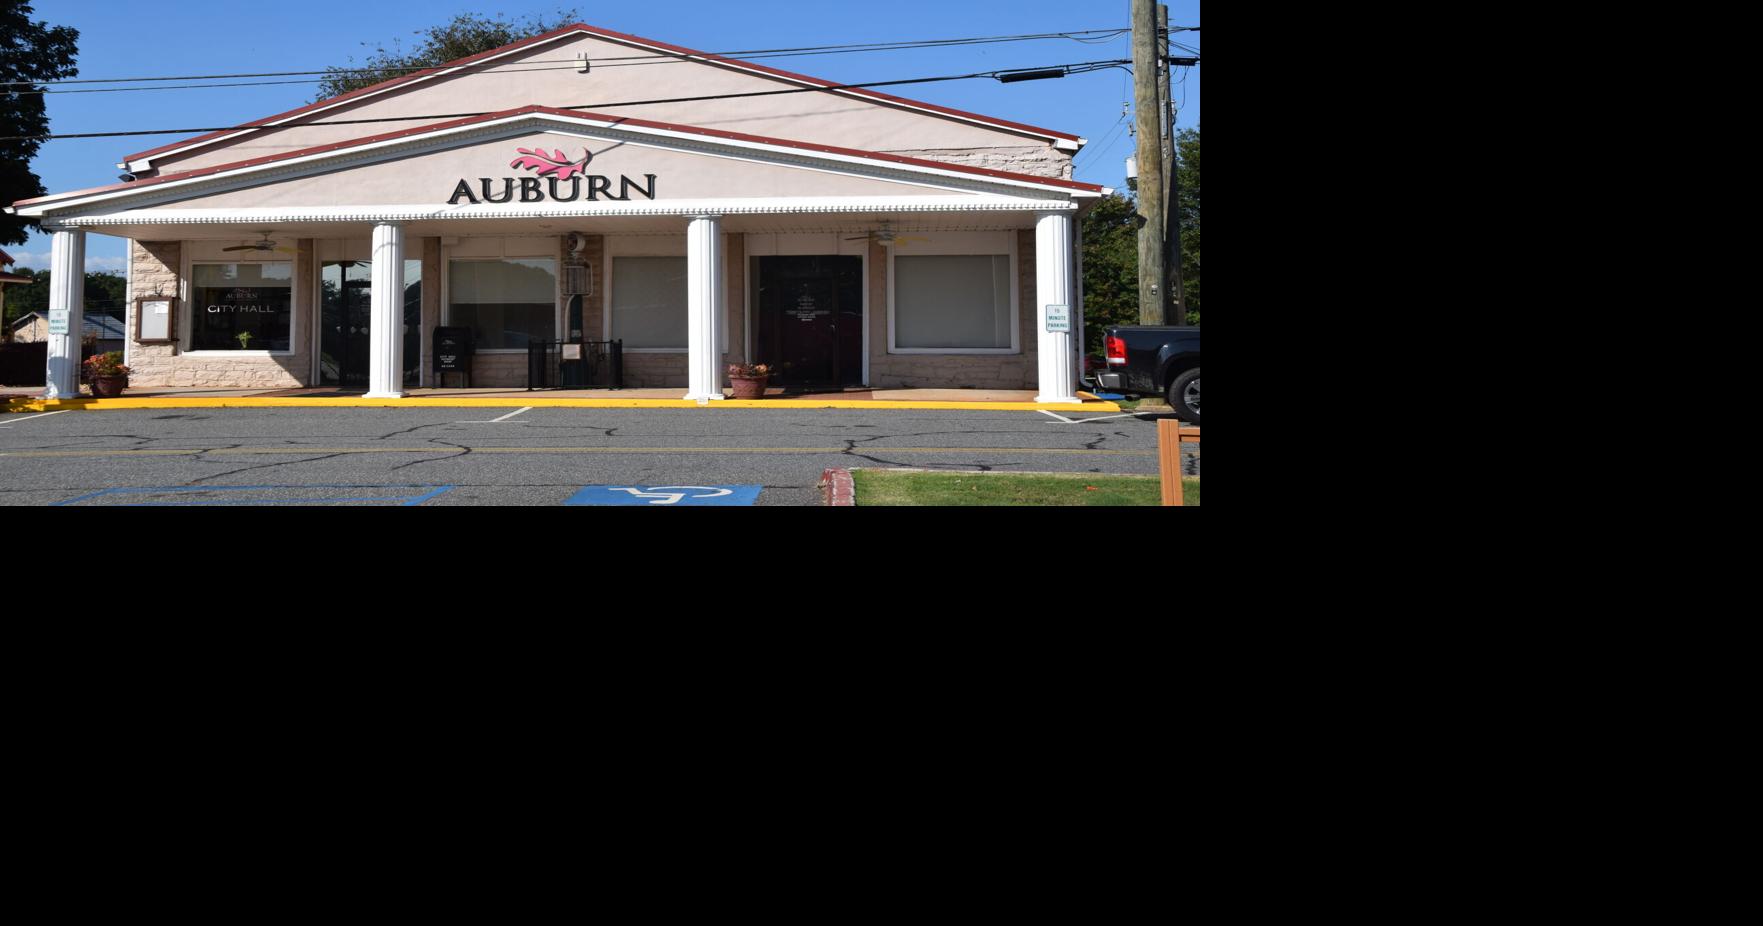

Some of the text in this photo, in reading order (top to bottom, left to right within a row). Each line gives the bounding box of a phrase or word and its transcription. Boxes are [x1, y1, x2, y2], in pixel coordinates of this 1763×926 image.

[446, 173, 657, 205] AUBURN
[207, 305, 275, 313] CITY HALL
